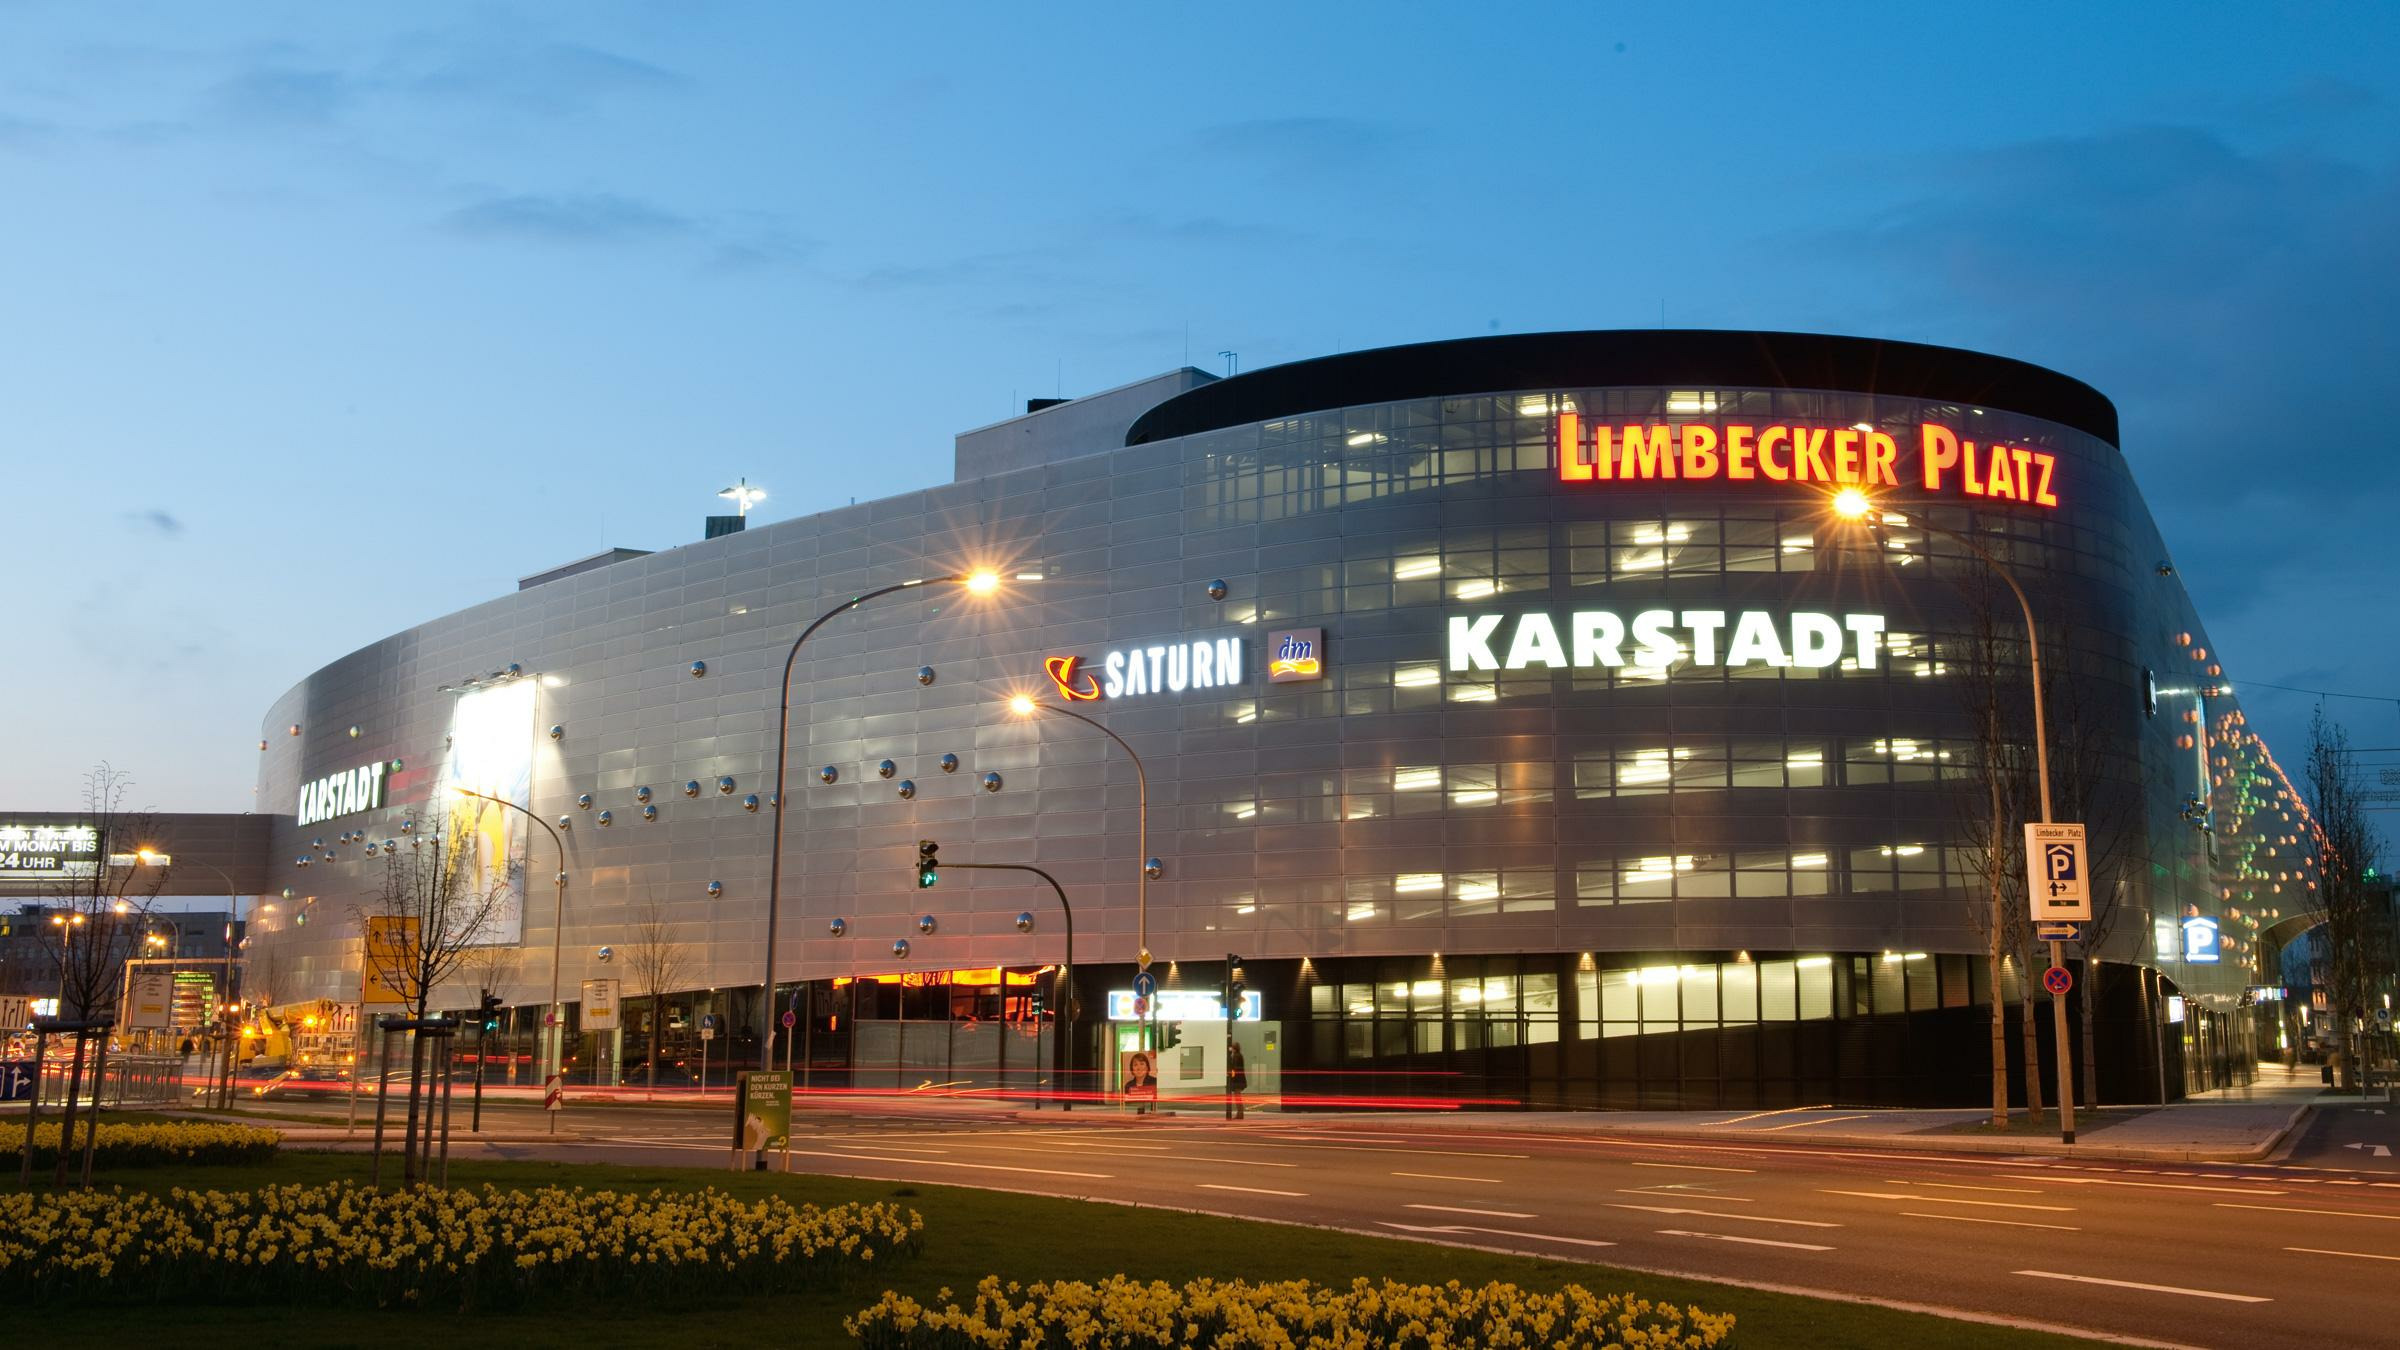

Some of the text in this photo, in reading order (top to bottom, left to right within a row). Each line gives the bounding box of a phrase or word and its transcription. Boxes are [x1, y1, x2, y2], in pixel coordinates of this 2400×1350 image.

[1558, 412, 2058, 507] LIMBECKER PLATZ
[1279, 634, 1313, 662] dm
[1448, 609, 1886, 671] KARSTADT
[1104, 637, 1240, 699] SATURN
[298, 761, 383, 827] KARSTADT
[14, 841, 69, 852] MONAT
[72, 841, 97, 852] BIS
[2036, 829, 2081, 837] Limbecker Platz
[23, 857, 56, 869] UHR
[2052, 855, 2070, 879] P
[2188, 927, 2213, 953] P
